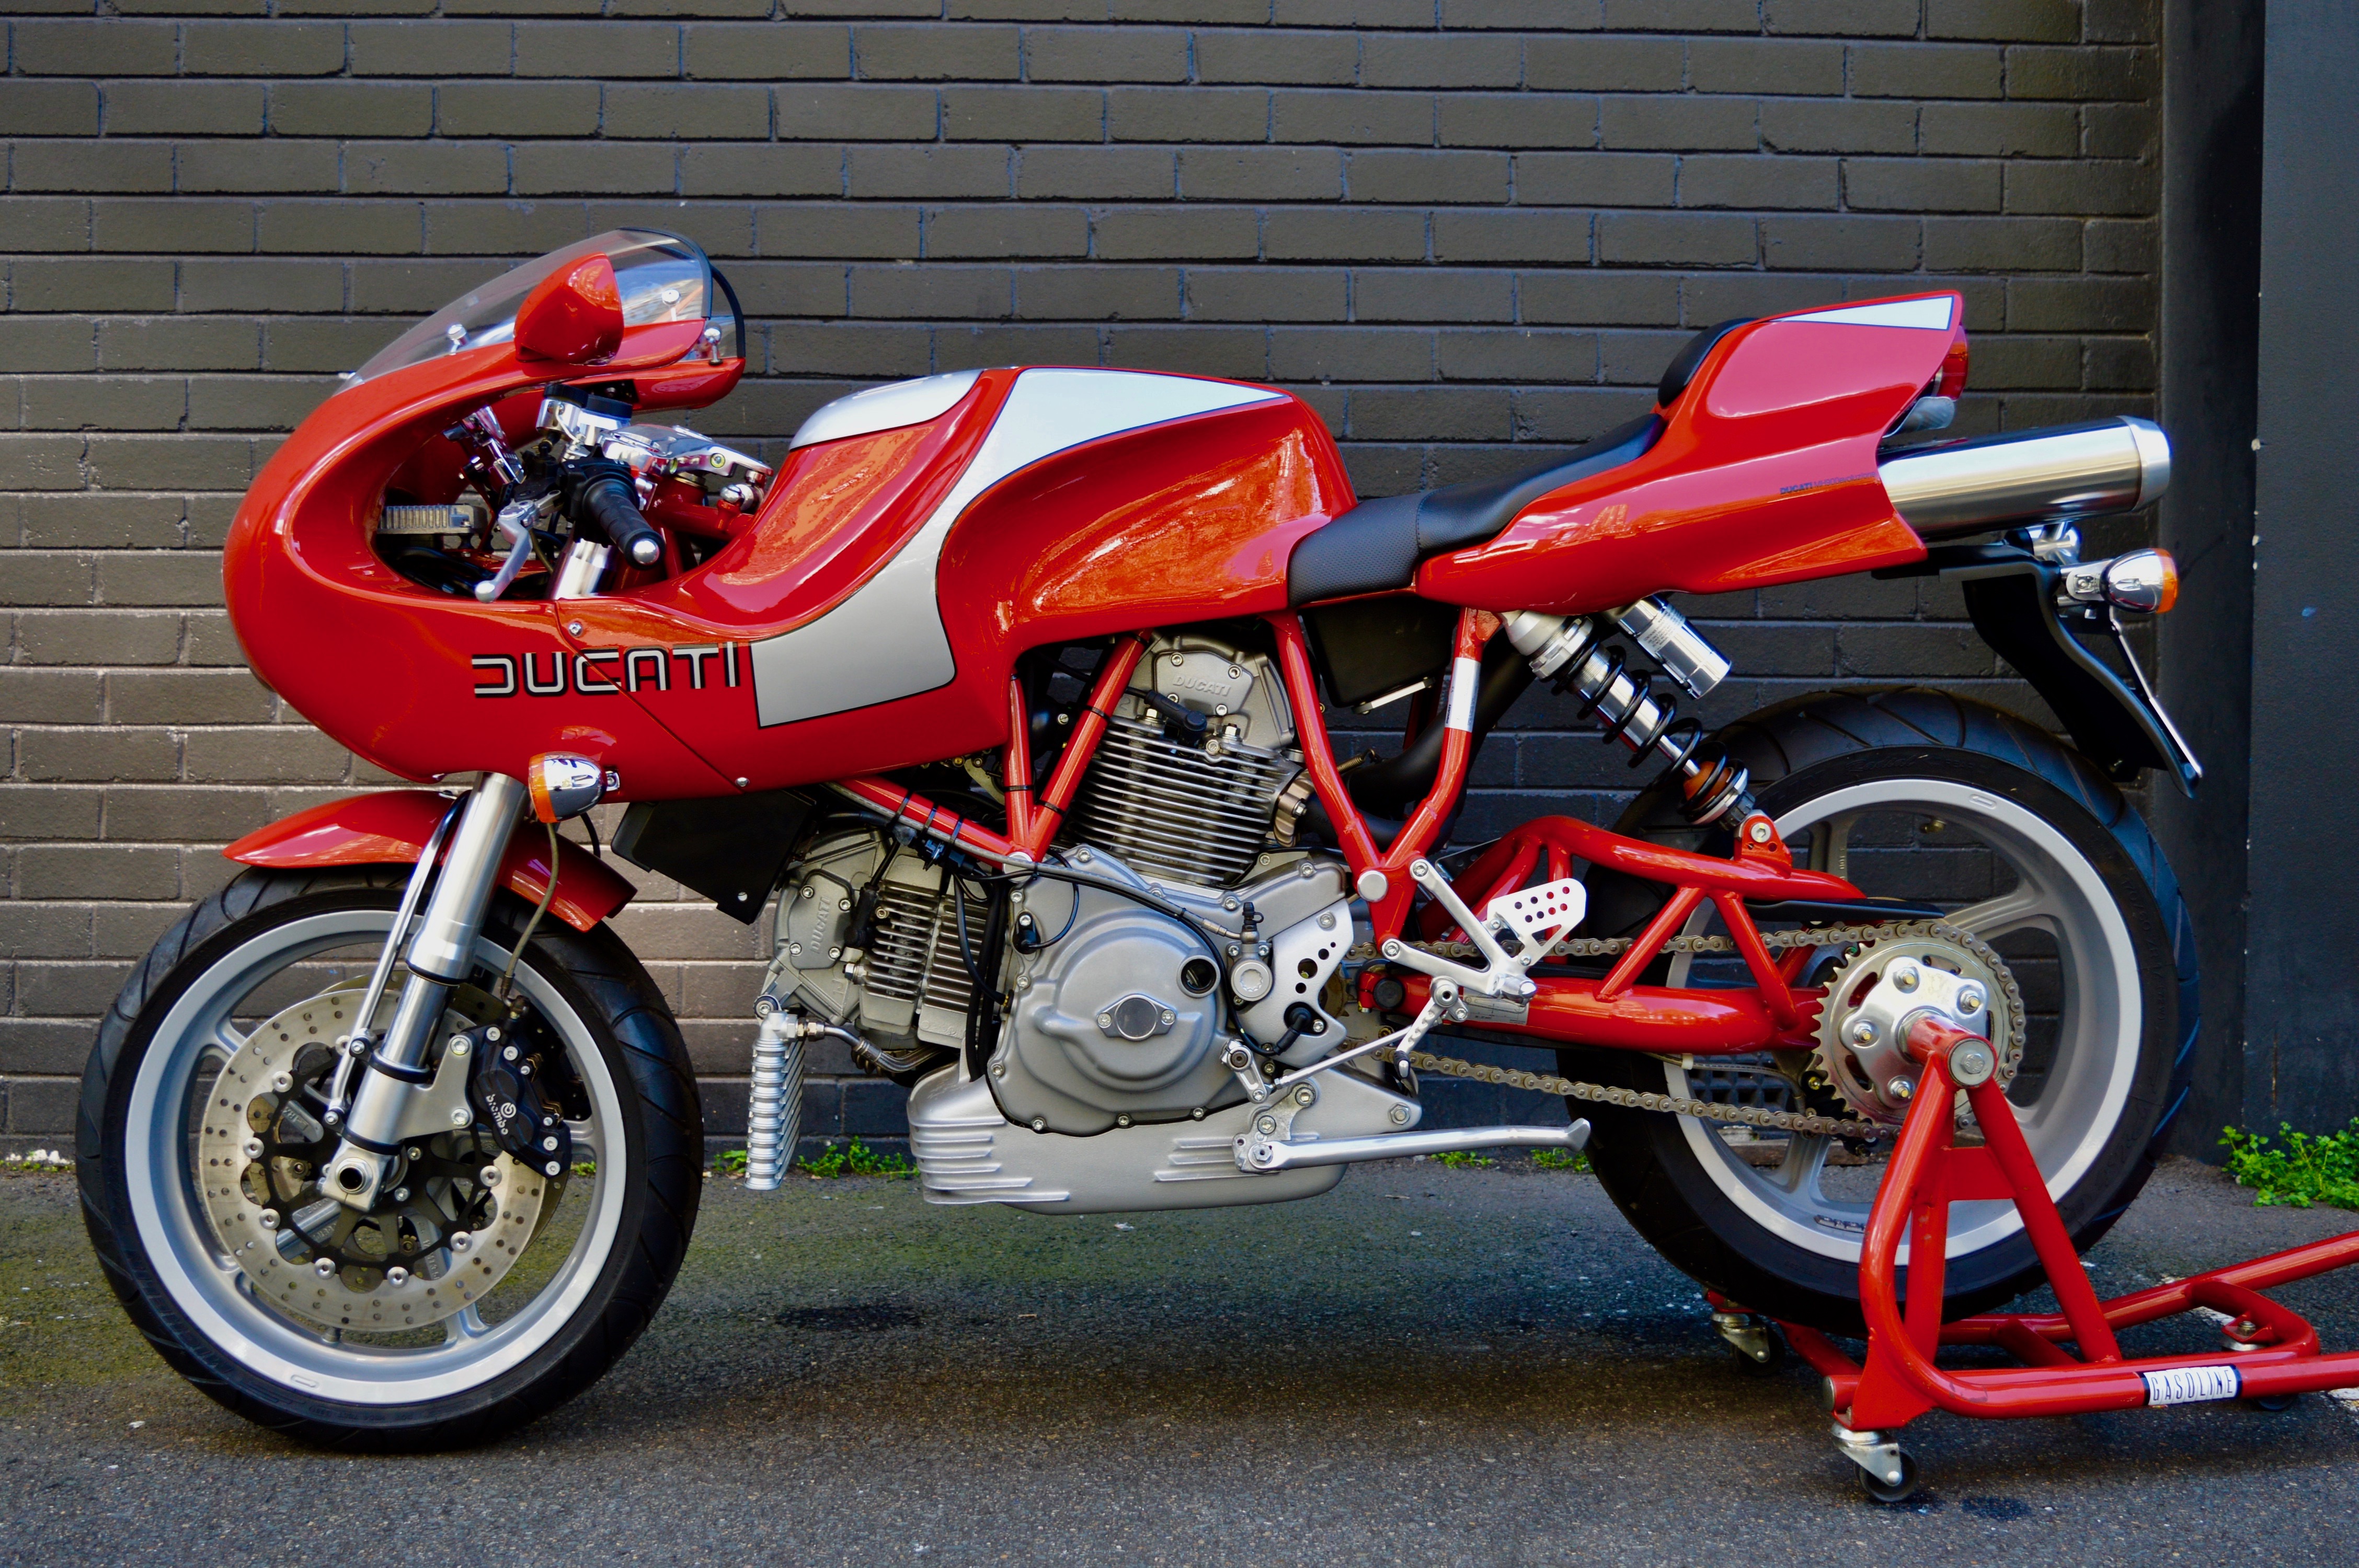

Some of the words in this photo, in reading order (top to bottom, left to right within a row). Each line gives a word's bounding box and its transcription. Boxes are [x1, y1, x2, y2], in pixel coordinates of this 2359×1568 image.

[1780, 482, 1813, 494] DUCATI
[472, 641, 740, 697] DUCATI
[1172, 675, 1231, 696] DUCATI
[810, 896, 831, 954] DUCATI
[486, 1093, 509, 1135] brembo
[2150, 1369, 2233, 1401] GASOLINE
